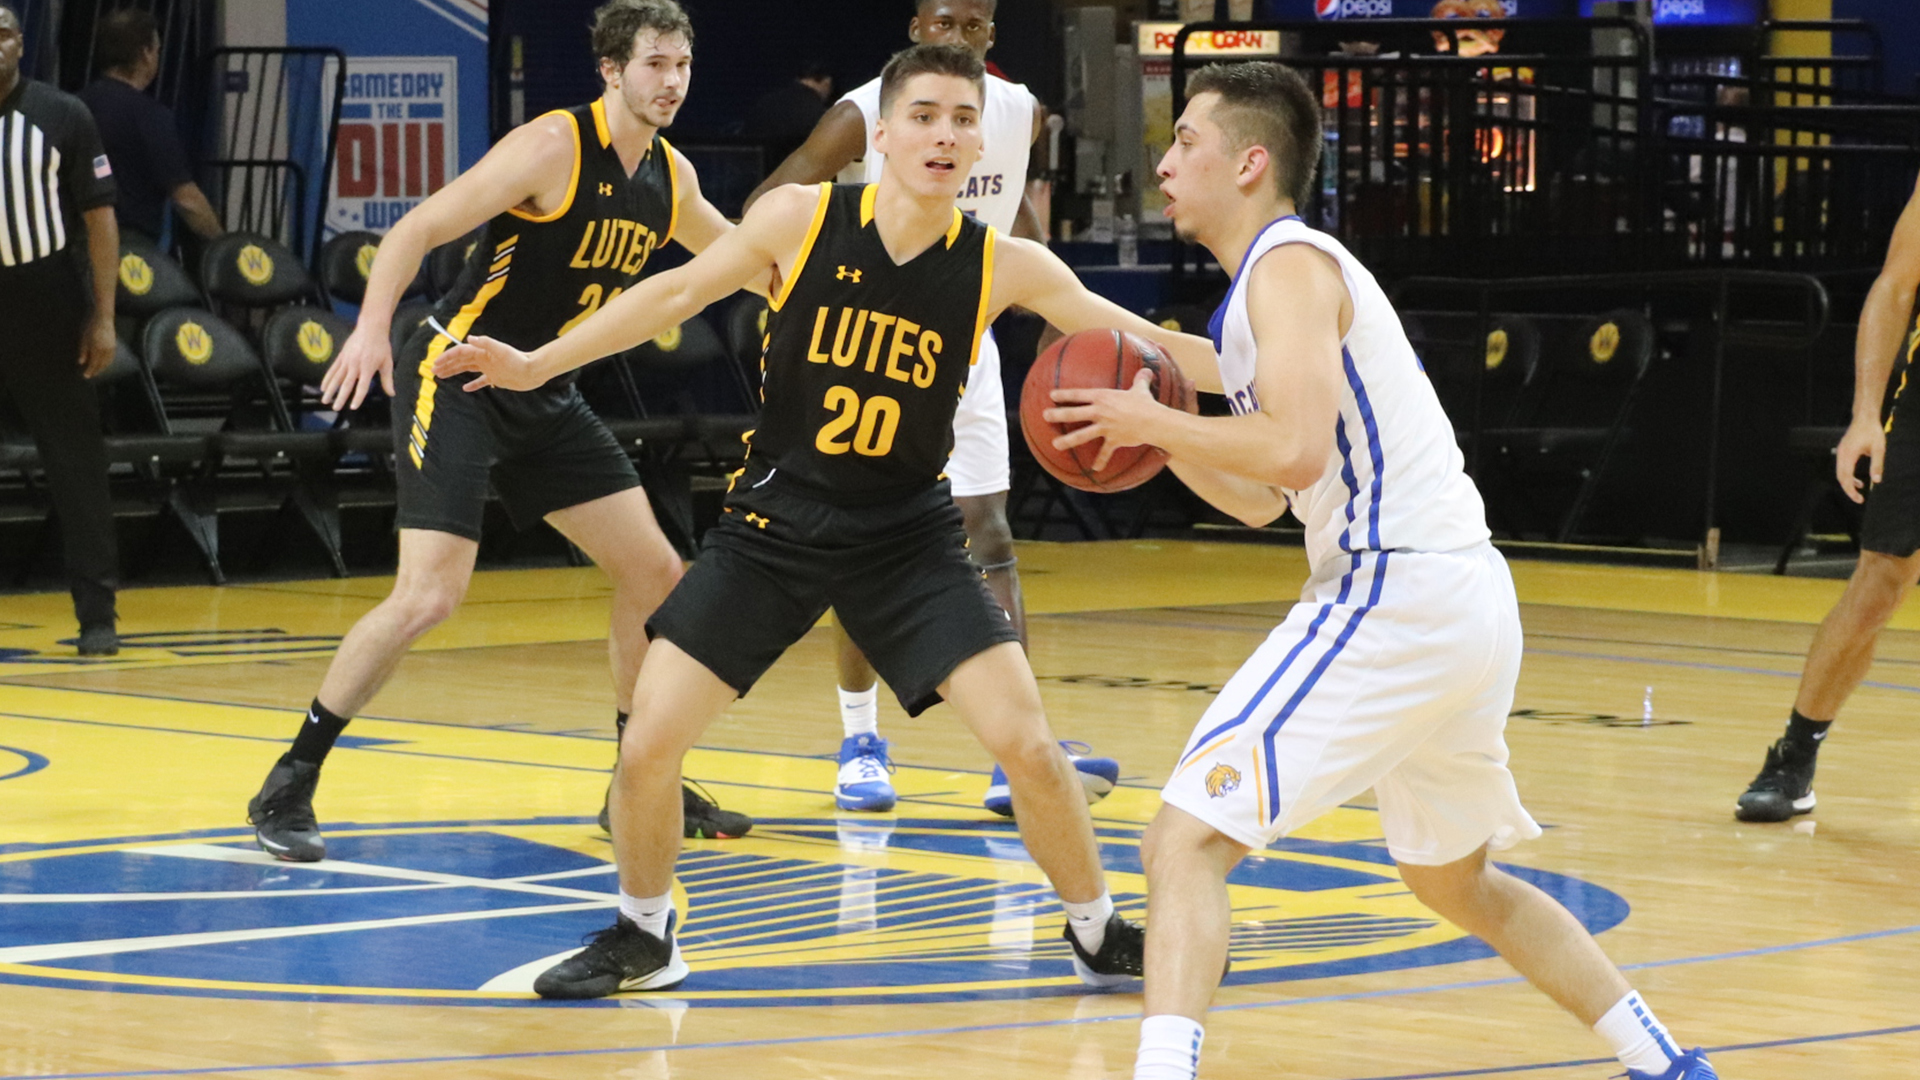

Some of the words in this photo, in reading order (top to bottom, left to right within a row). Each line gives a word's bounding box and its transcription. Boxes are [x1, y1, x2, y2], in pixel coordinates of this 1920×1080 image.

[378, 103, 403, 118] THE
[956, 174, 1003, 198] ATS
[569, 219, 657, 275] LUTES
[557, 283, 622, 337] 2
[807, 306, 943, 389] LUTES
[815, 385, 901, 456] 20
